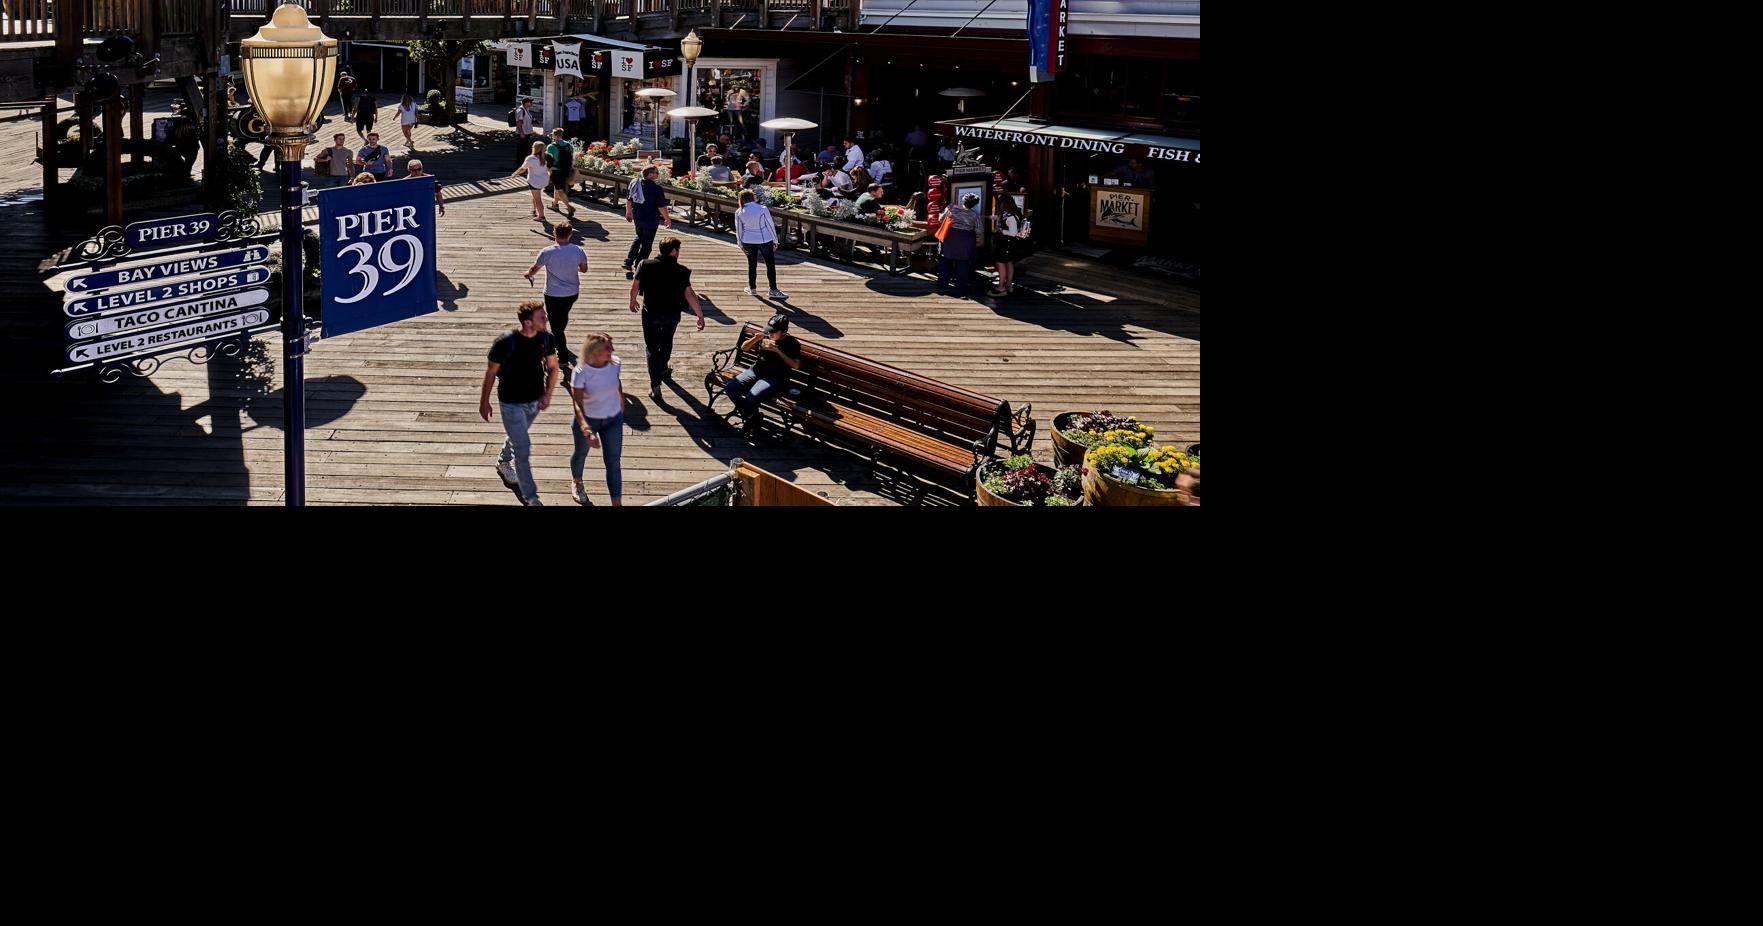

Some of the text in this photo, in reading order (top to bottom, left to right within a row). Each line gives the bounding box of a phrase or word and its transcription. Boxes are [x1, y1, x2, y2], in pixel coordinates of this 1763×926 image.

[557, 59, 579, 70] USA
[661, 59, 673, 68] SF
[955, 126, 1125, 154] WATERFRONT DINING
[1147, 147, 1191, 162] FISH
[1100, 199, 1140, 217] MARKET
[138, 220, 210, 242] PIER 39
[335, 205, 420, 241] PIER
[118, 256, 218, 283] BAY VIEWS
[334, 234, 424, 303] 39
[97, 275, 238, 310] LEVEL 2 SHOPS
[114, 297, 238, 329] TACO CANTINA
[97, 319, 237, 355] LEVEL 2 RESTAURANTS
